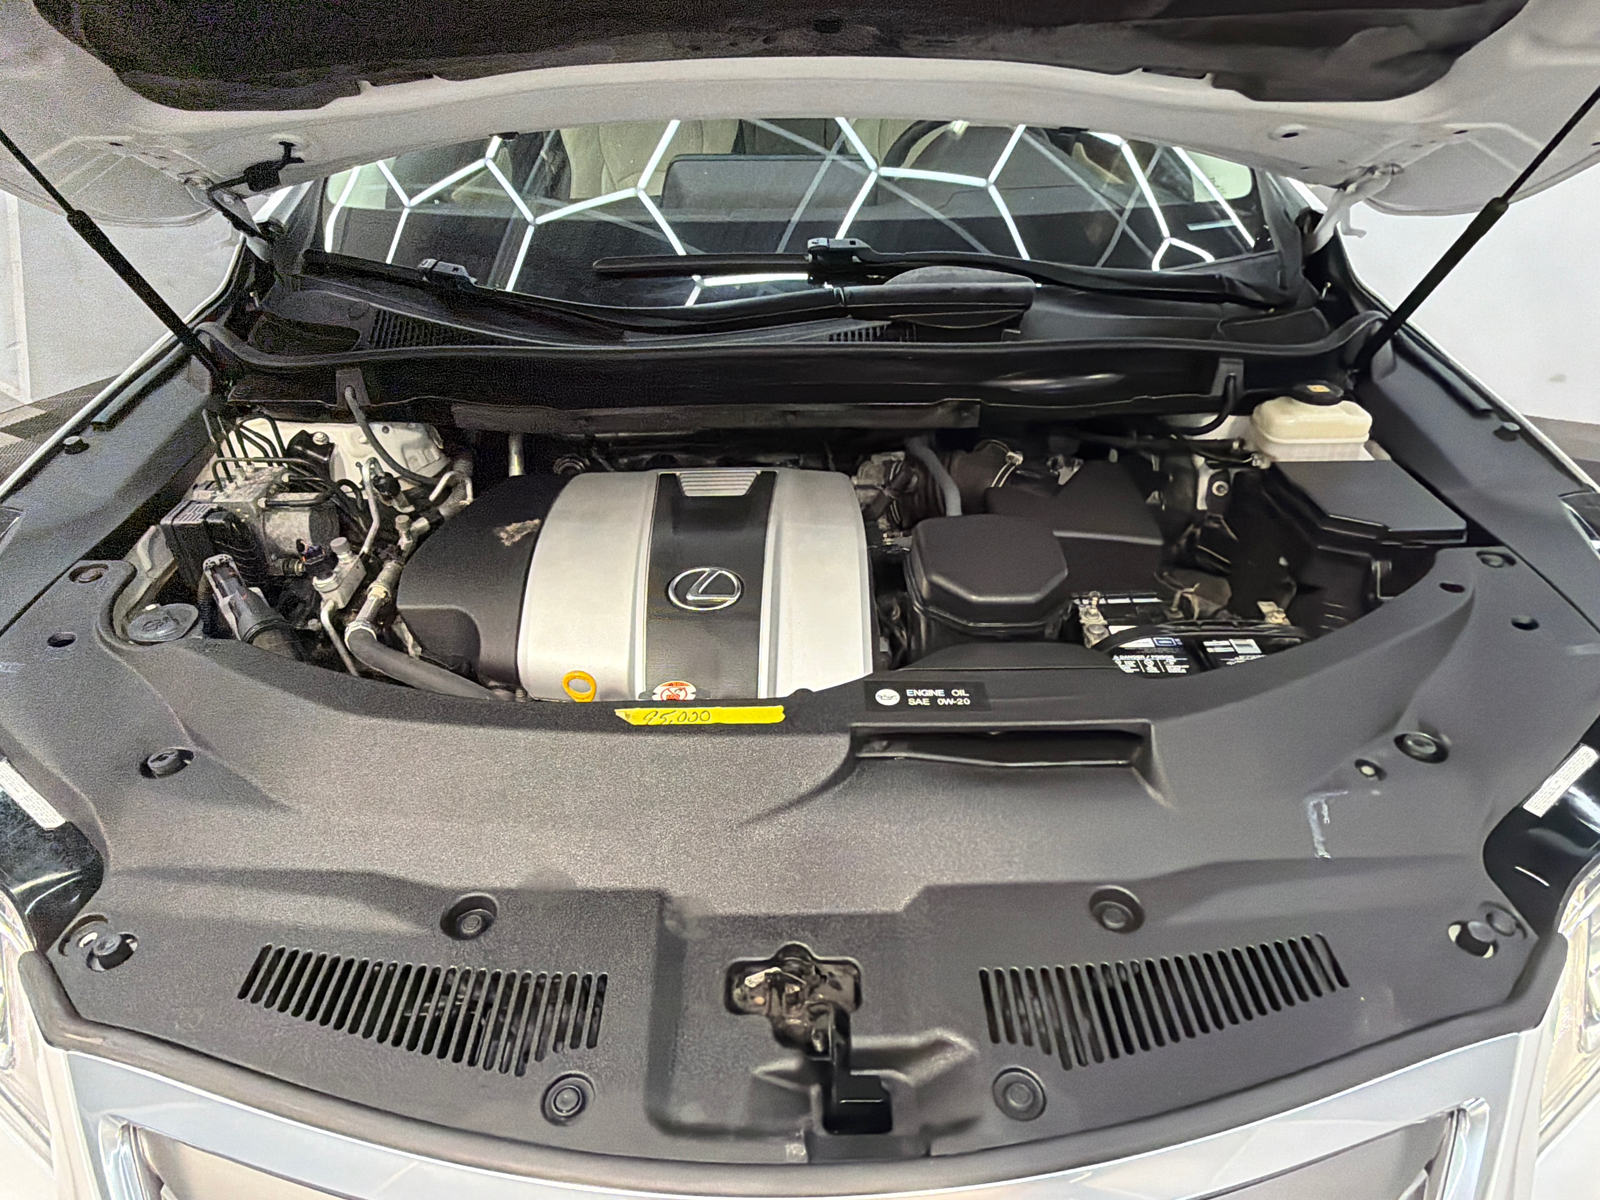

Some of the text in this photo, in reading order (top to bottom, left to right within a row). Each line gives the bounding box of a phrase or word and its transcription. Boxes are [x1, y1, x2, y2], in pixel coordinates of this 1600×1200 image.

[906, 689, 970, 697] ENGINE OIL
[908, 698, 971, 706] SAE 0W-20
